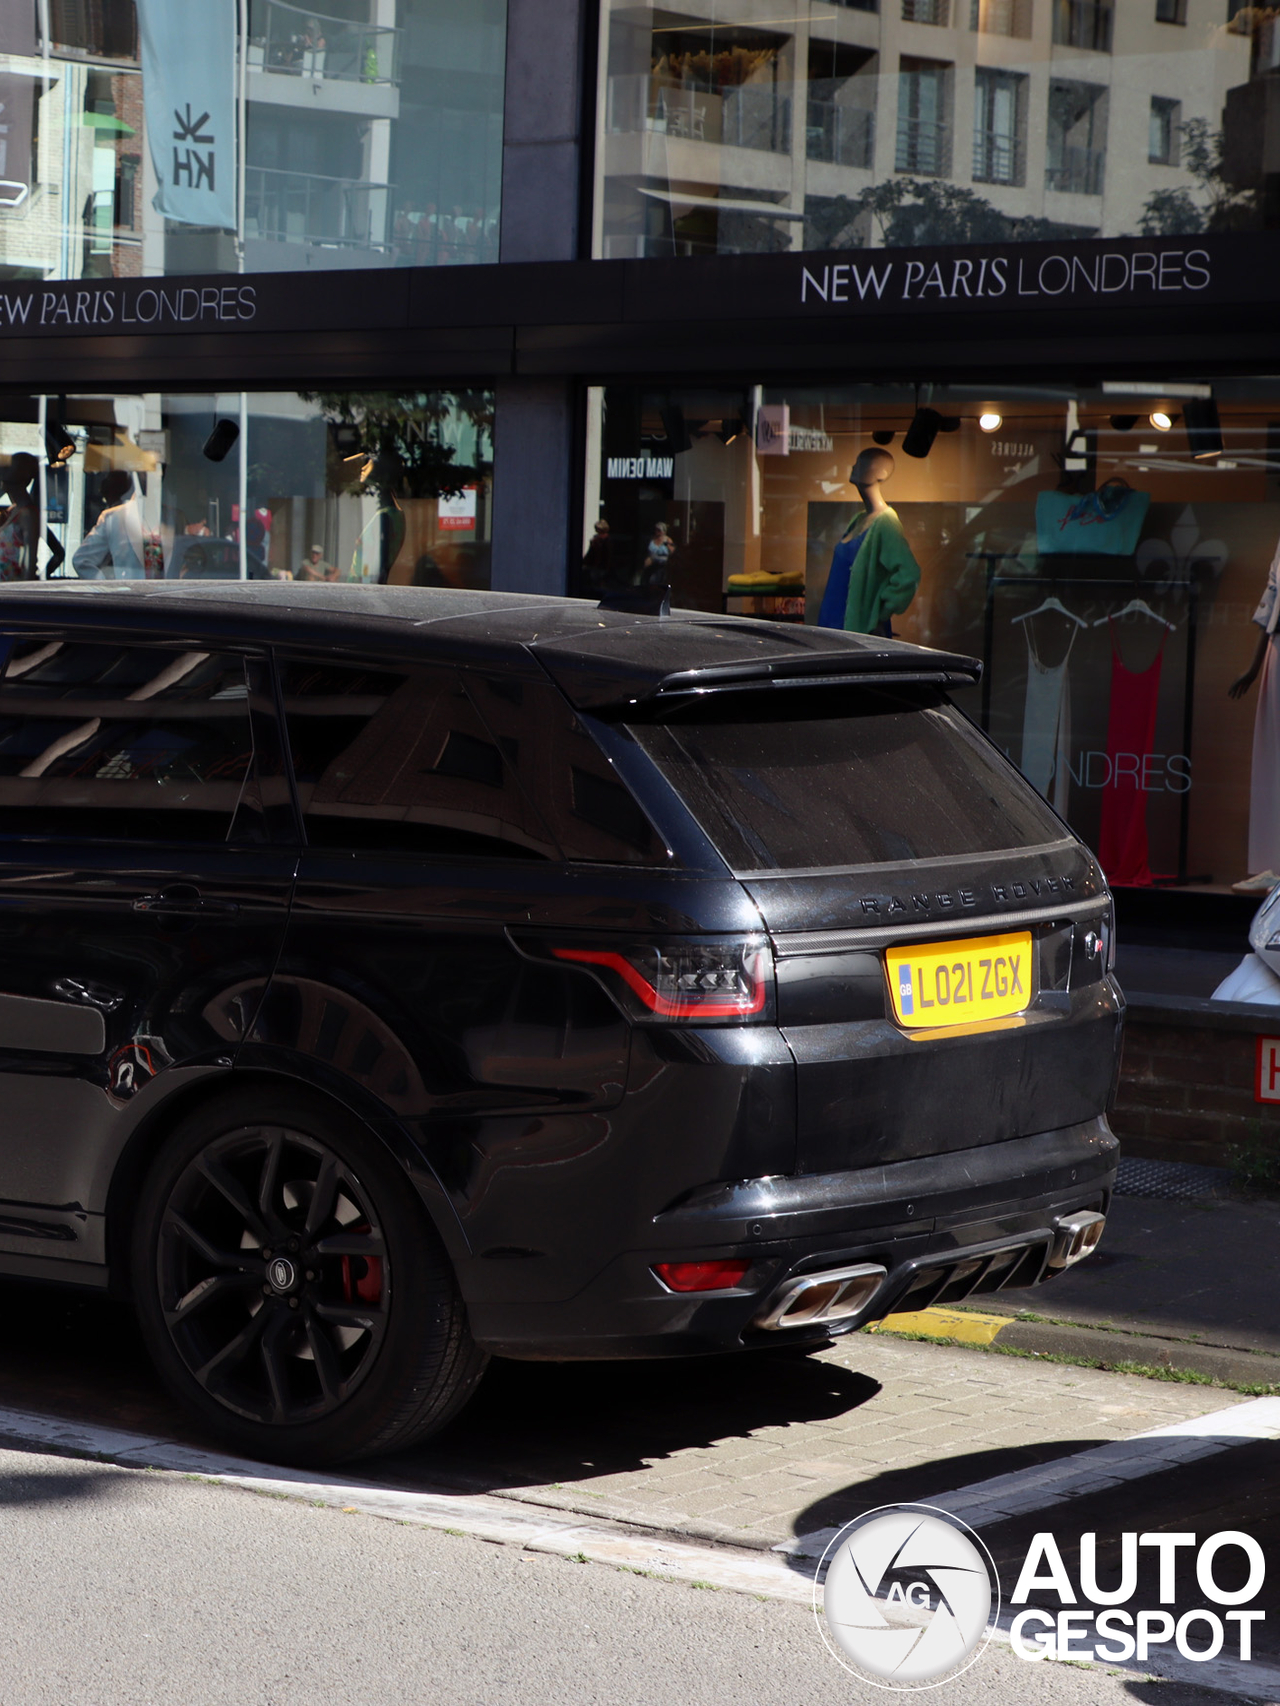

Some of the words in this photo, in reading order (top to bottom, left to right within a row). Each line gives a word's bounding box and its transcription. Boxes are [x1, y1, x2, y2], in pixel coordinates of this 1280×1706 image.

[801, 263, 893, 302] NEW
[901, 257, 1009, 299] PARIS
[1018, 250, 1211, 295] LONDRES
[39, 290, 116, 325] PARIS
[121, 286, 257, 322] LONDRES
[859, 889, 976, 914] RANGE
[992, 876, 1074, 901] ROVER
[899, 983, 912, 997] GB
[979, 955, 1024, 1000] ZGX
